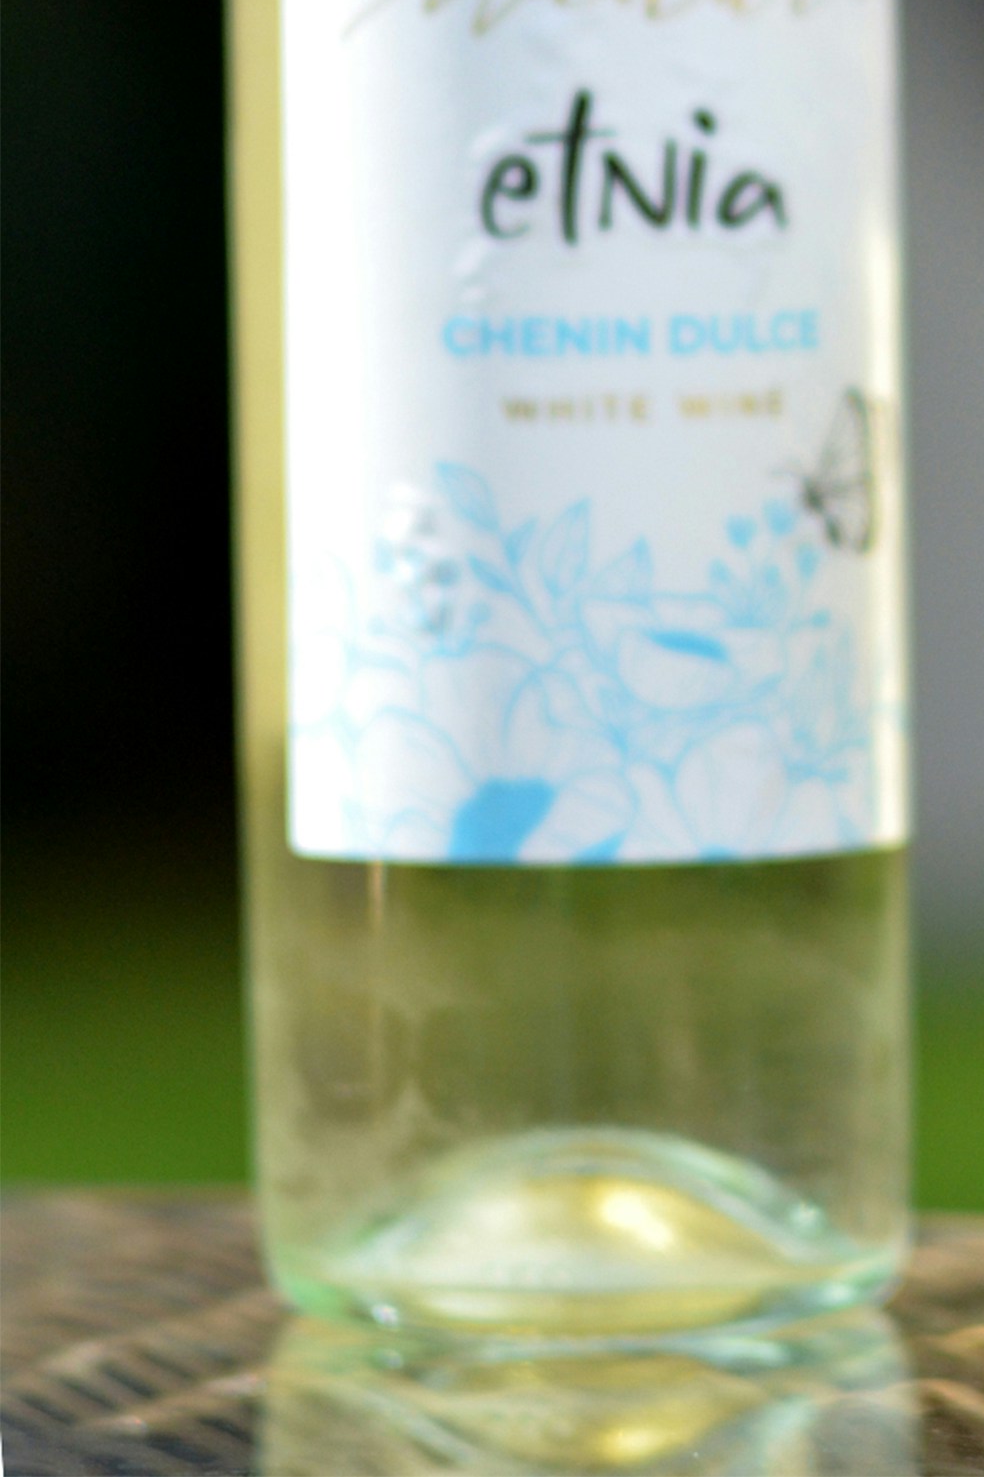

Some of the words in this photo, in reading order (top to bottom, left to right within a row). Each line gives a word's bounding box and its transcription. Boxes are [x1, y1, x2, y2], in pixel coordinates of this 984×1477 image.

[442, 316, 651, 357] CHENIN
[667, 309, 820, 355] DULCE
[501, 392, 648, 422] WHITE
[676, 387, 784, 419] WINE
